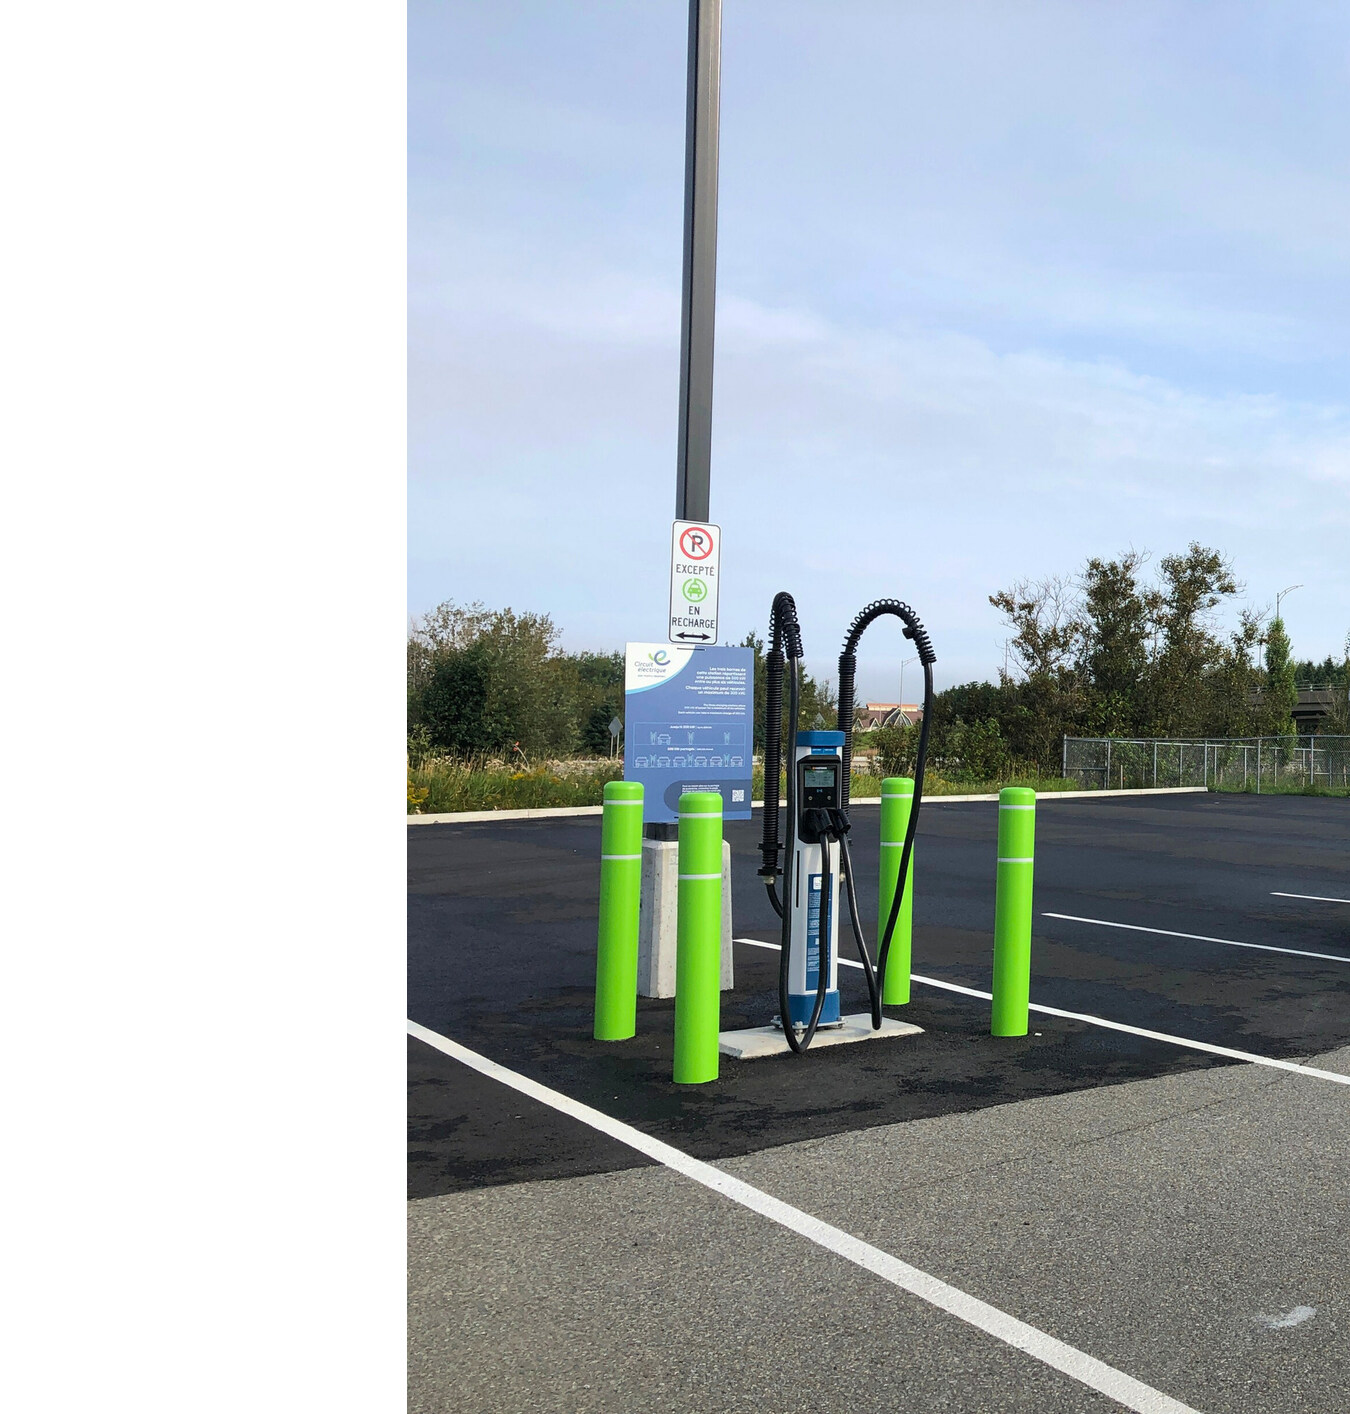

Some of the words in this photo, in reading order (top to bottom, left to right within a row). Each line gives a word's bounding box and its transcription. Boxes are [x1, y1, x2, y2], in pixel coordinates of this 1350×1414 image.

[676, 563, 715, 576] EXCEPTÉ
[688, 606, 700, 615] EN
[672, 617, 715, 629] RECHARGE
